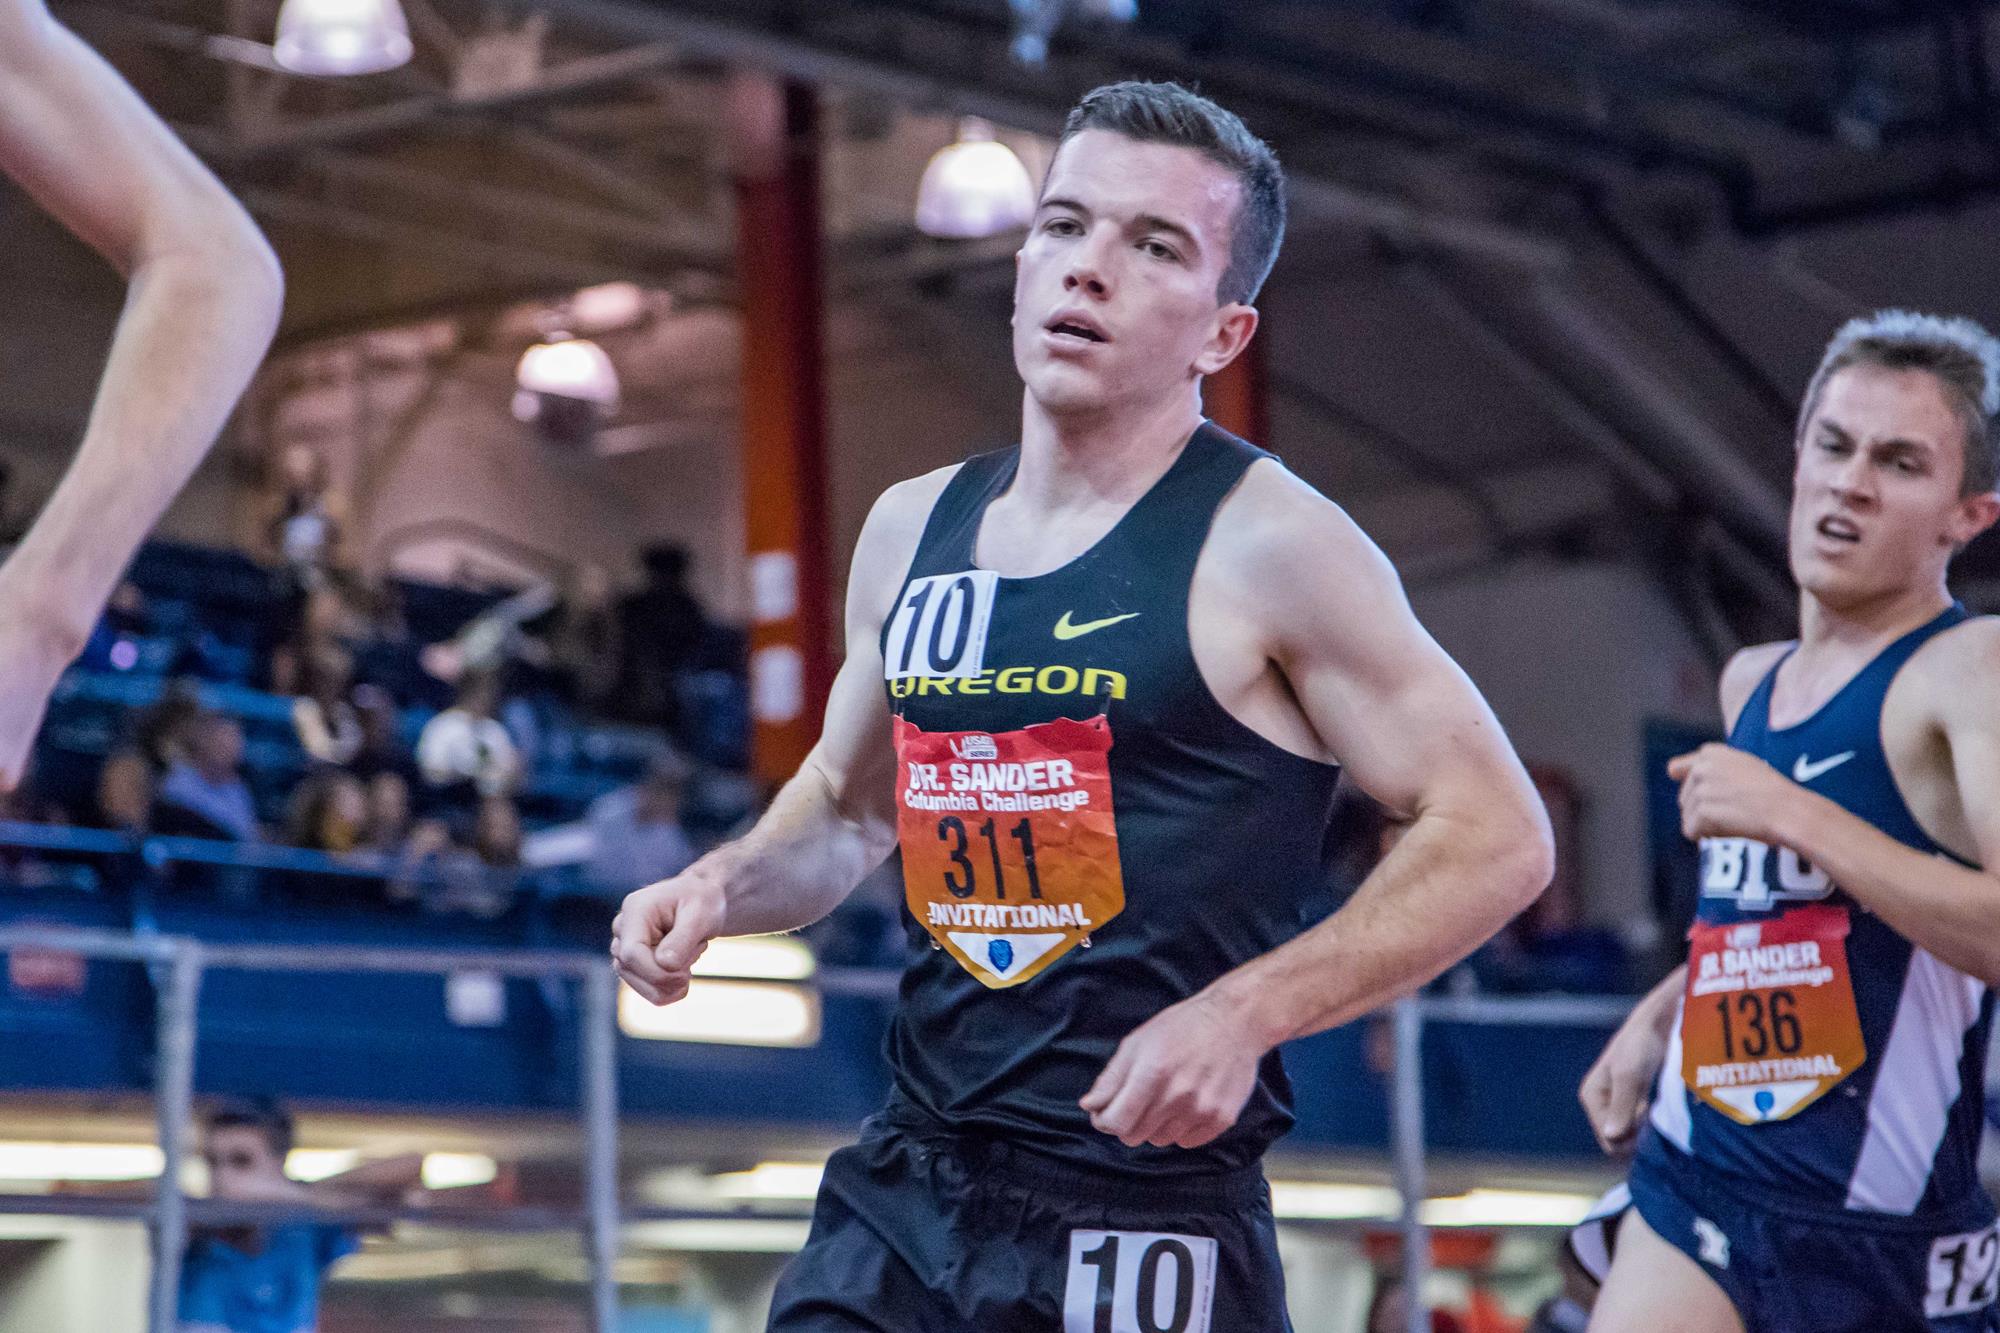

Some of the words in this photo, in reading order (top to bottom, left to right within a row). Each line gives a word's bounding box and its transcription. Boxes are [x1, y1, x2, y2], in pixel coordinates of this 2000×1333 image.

[898, 576, 976, 673] 10
[890, 665, 1127, 700] OREGON
[904, 788, 979, 812] Columbia
[981, 790, 1090, 812] Challenge
[907, 761, 946, 790] DR.
[950, 759, 1075, 792] SANDER
[938, 816, 1042, 899] 311
[927, 901, 1092, 928] INVITATIONAL
[1723, 941, 1822, 976] SANDER
[1717, 991, 1803, 1060] 136
[1081, 1235, 1195, 1333] 10
[1940, 1231, 1999, 1307] 12
